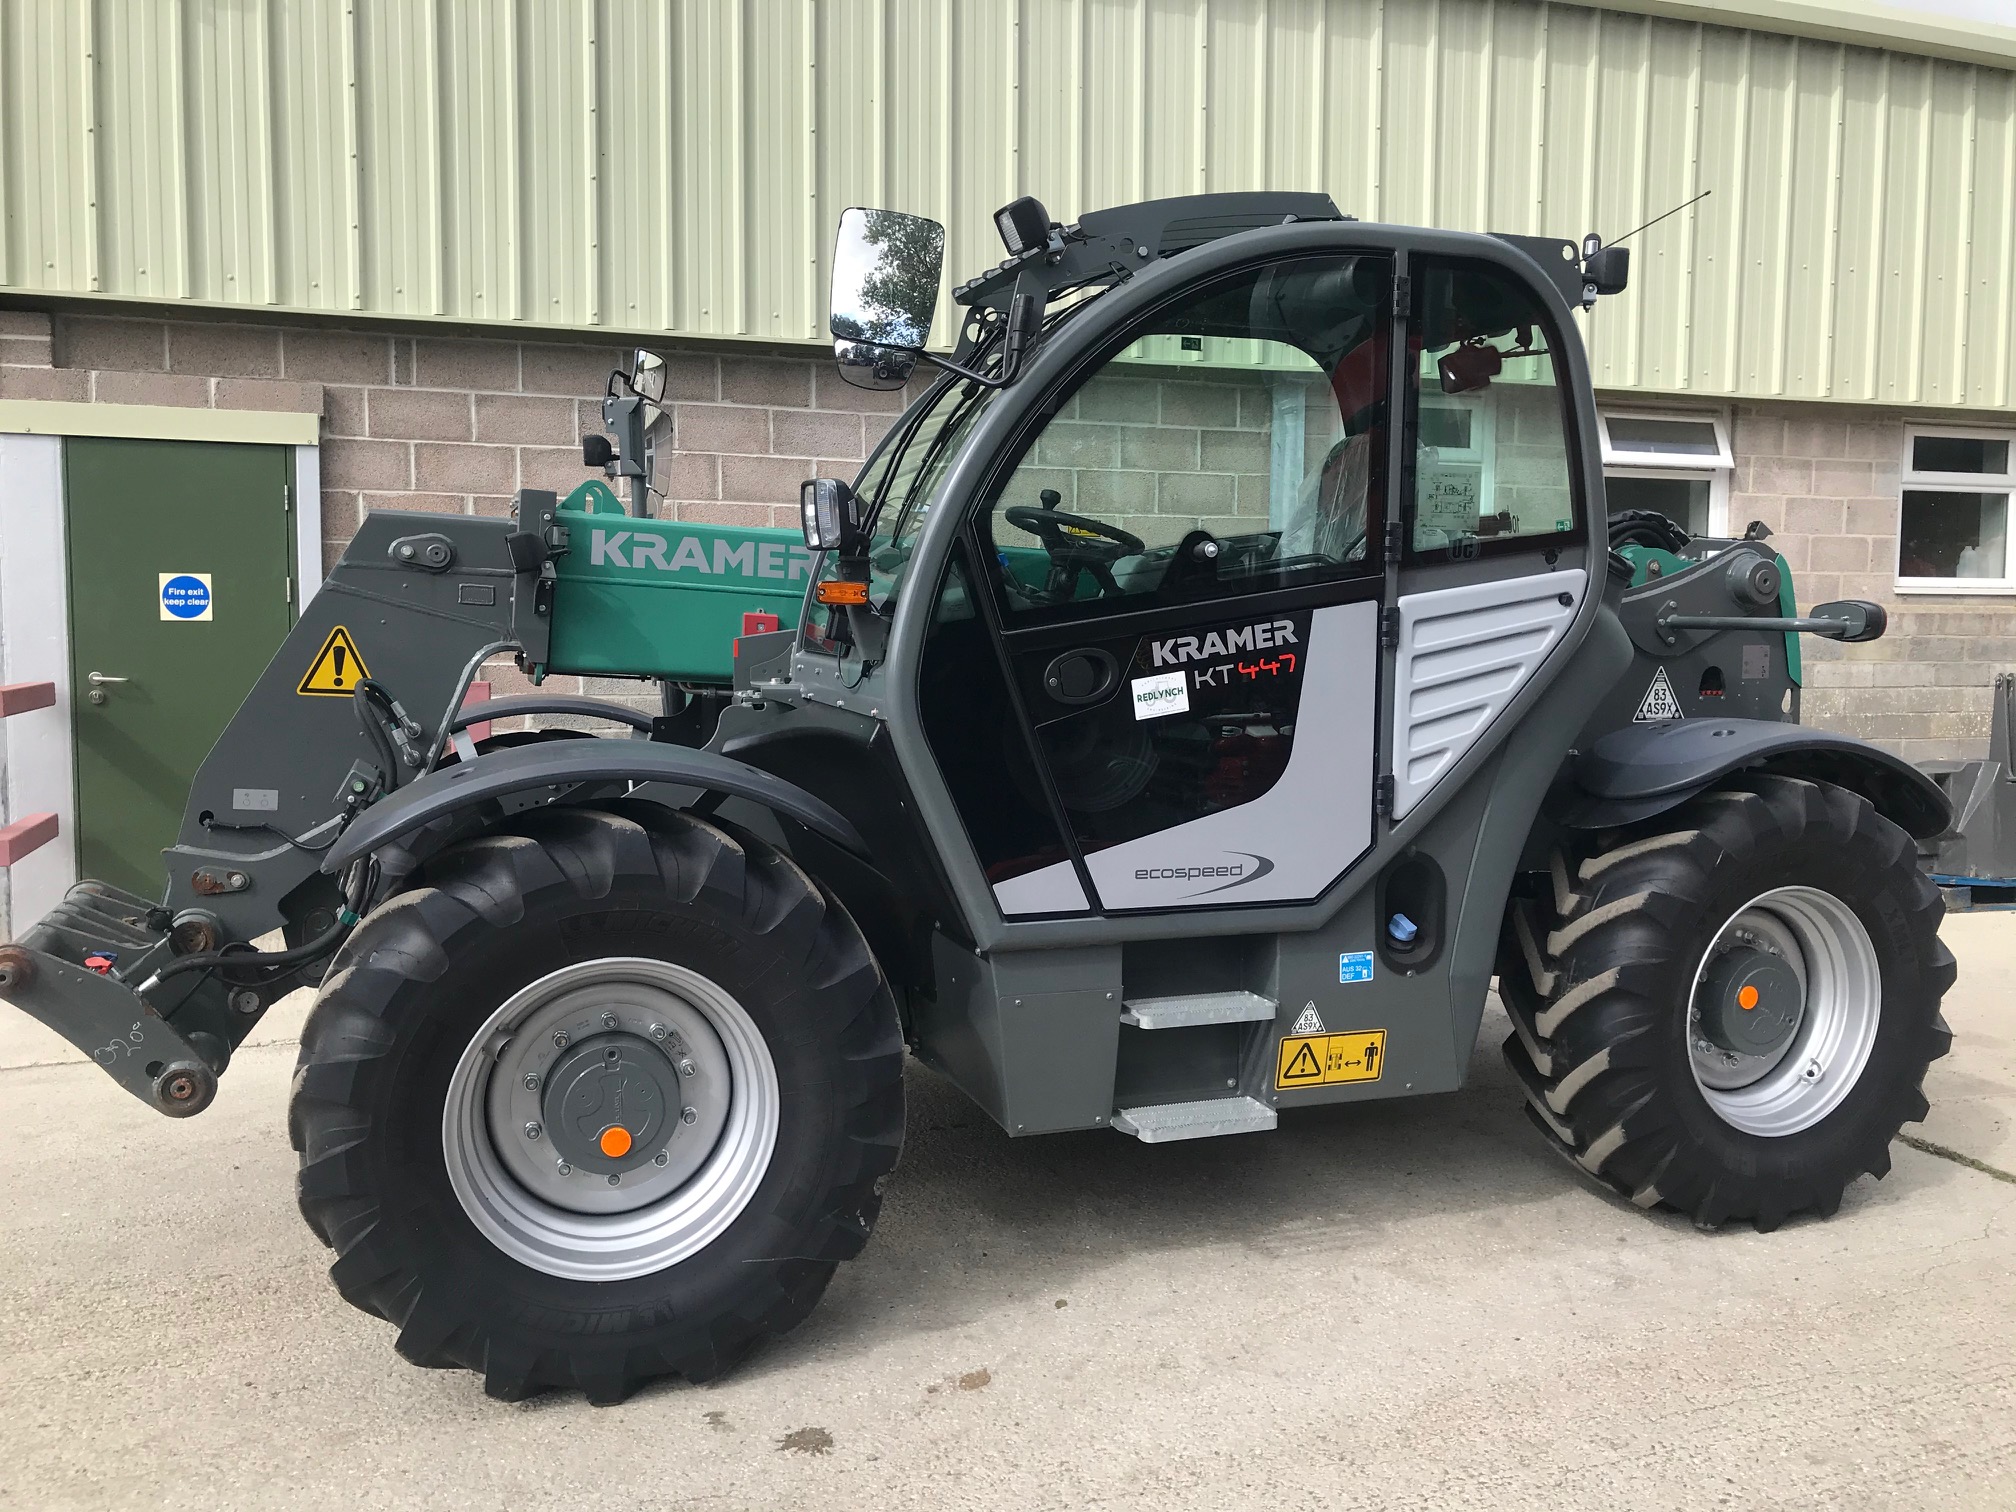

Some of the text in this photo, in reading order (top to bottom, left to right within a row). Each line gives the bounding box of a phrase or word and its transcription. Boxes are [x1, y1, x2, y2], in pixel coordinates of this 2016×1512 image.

[591, 529, 838, 580] KRAMER
[168, 588, 204, 596] Fire exit
[164, 597, 209, 607] keep clear
[1151, 619, 1299, 668] KRAMER
[1194, 663, 1235, 690] KT
[1237, 653, 1297, 680] 447
[1136, 686, 1184, 704] REDLYNCH
[1653, 688, 1667, 701] 83
[1646, 702, 1674, 716] AS9X
[1134, 863, 1243, 882] ecospeed
[1304, 1013, 1313, 1022] 83
